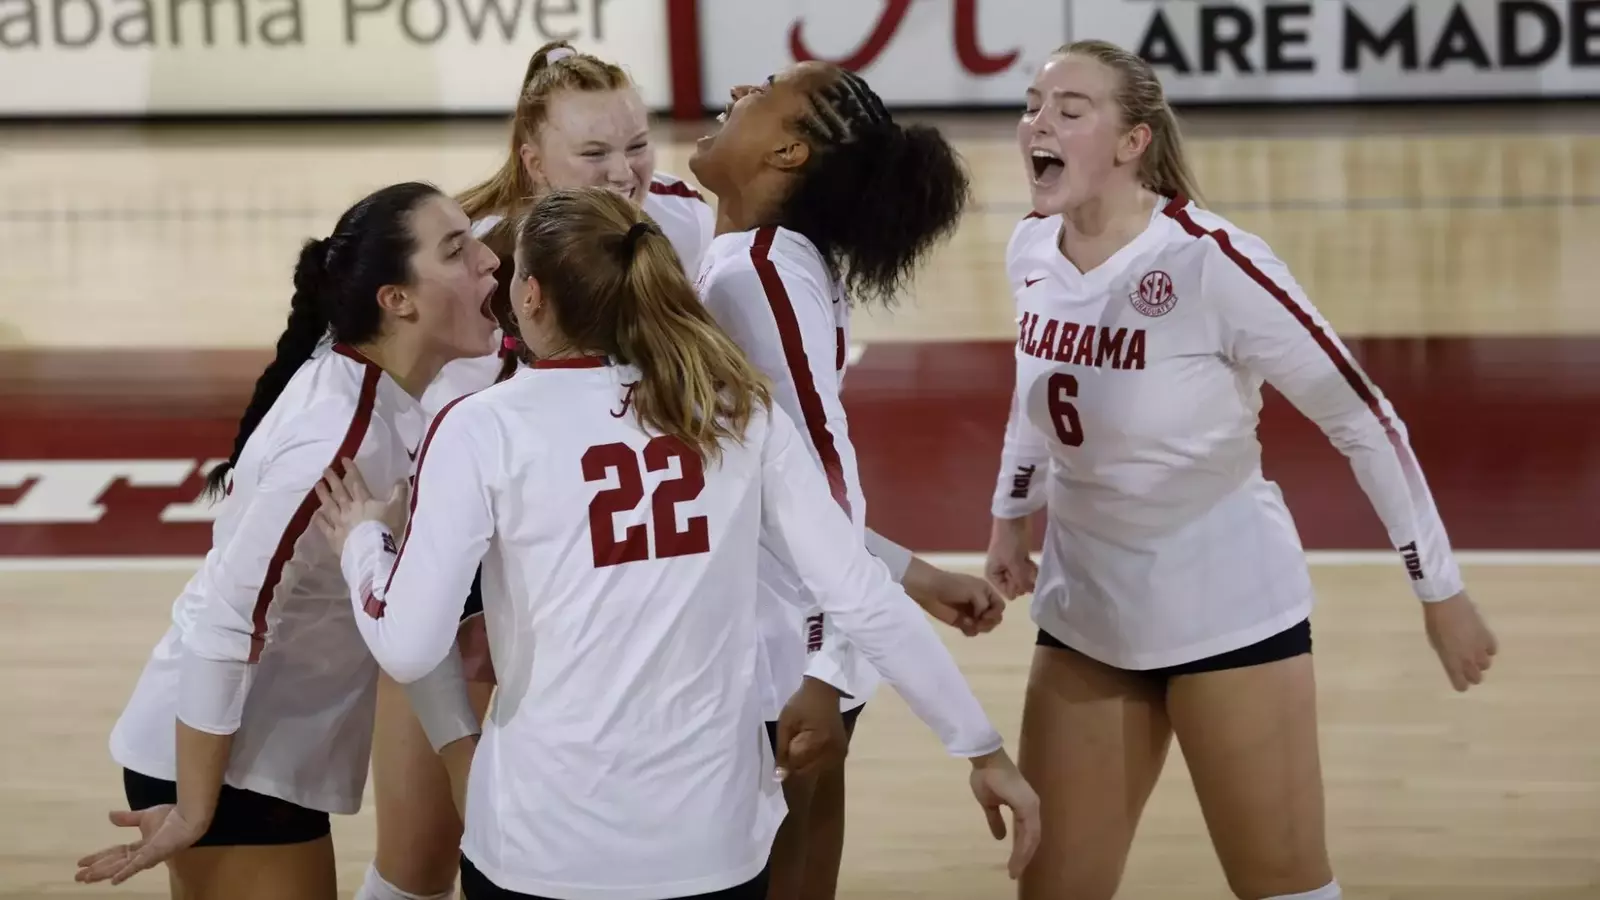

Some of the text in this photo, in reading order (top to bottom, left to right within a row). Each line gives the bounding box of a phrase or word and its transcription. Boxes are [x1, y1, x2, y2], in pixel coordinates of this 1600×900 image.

[344, 0, 611, 43] Power
[1137, 0, 1600, 75] ARE MADE
[1141, 272, 1173, 305] SEC
[1047, 372, 1084, 447] 6
[580, 433, 711, 568] 22
[1399, 540, 1424, 580] TIDE
